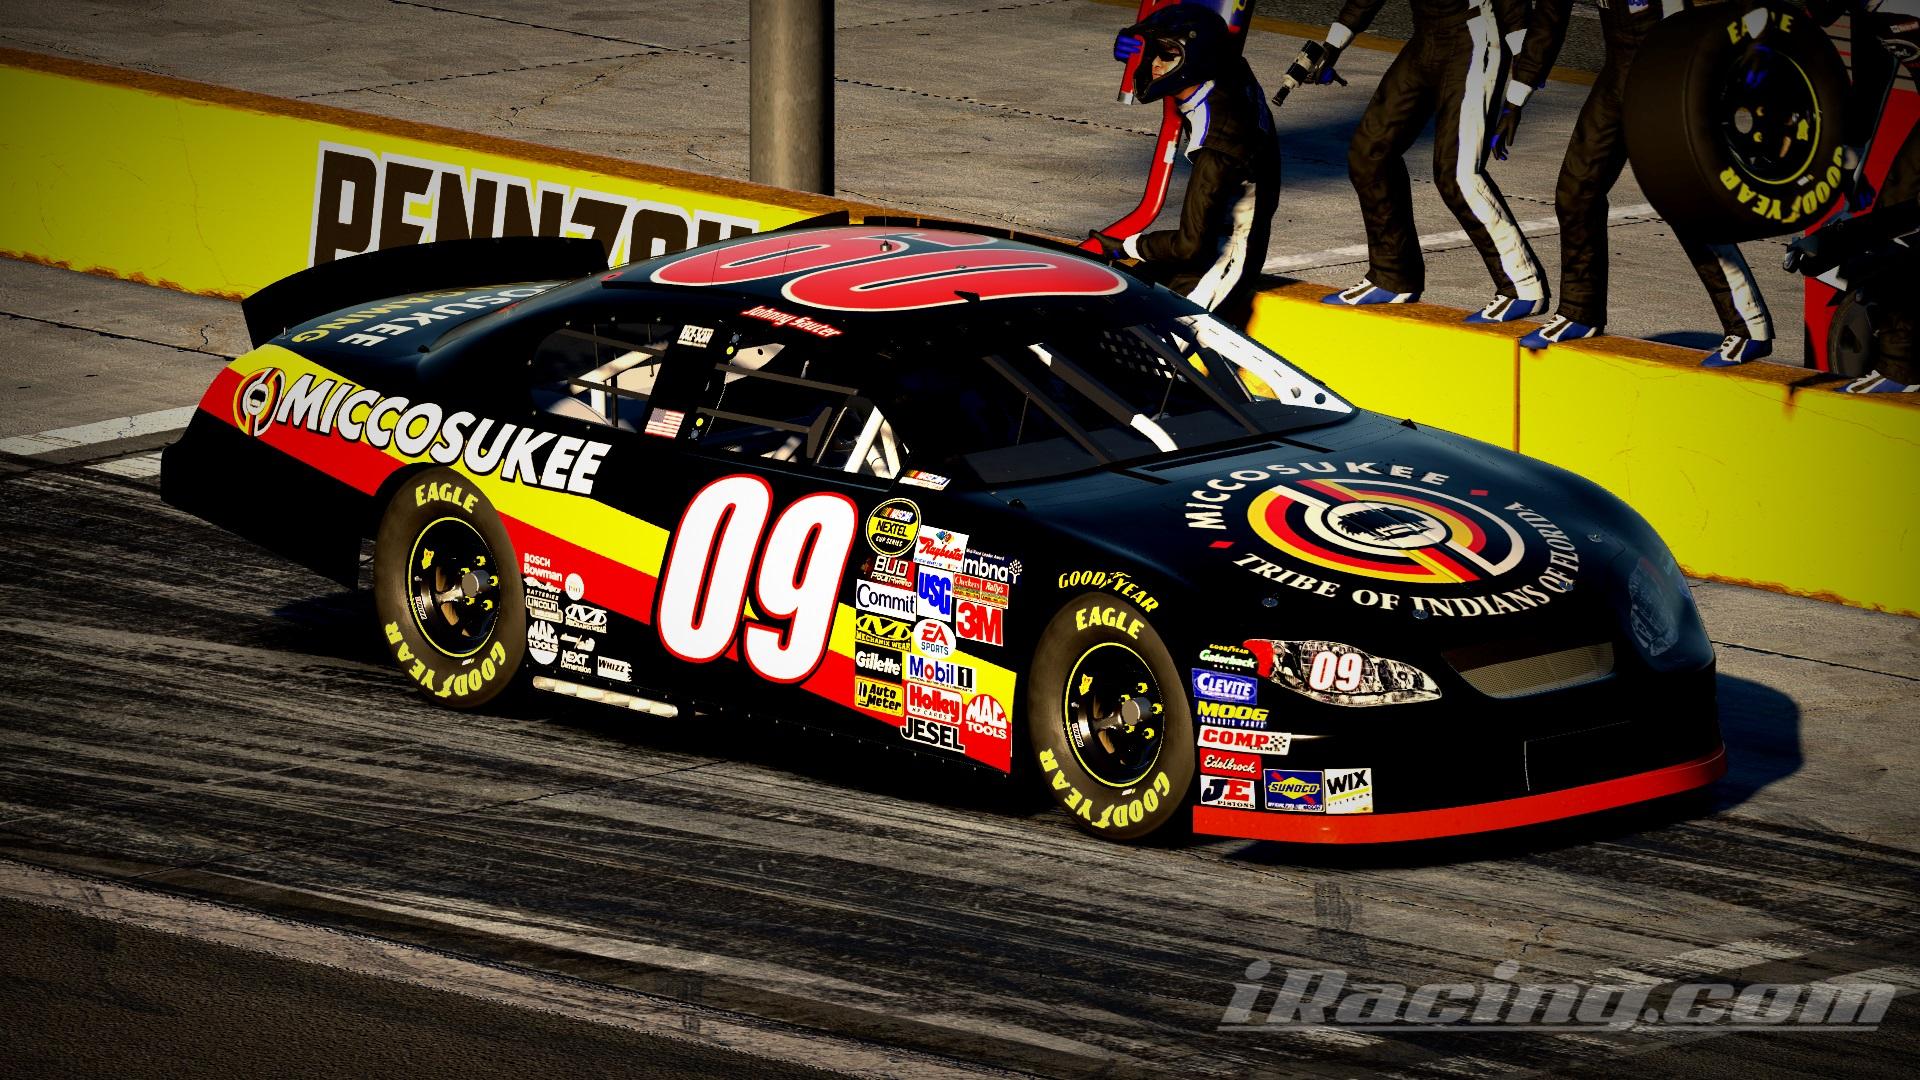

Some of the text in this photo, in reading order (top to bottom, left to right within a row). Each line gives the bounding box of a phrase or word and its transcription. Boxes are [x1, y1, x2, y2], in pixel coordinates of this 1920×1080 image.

[741, 305, 843, 338] Johnny Sauter
[276, 373, 612, 496] MICCOSUKEE
[415, 482, 479, 513] EAGLE
[1185, 461, 1450, 530] MICCOSUKEE
[875, 535, 887, 543] CUP
[876, 519, 908, 538] NEXTEL
[524, 553, 551, 567] BOSCH
[874, 555, 909, 577] BUD
[963, 557, 1009, 583] mbna
[1233, 501, 1580, 617] TRIBE OF INDIANS OF FLORIDA
[524, 563, 563, 582] Bowman
[659, 475, 860, 683] 09
[526, 588, 559, 600] BATTERIES
[857, 583, 914, 614] Commit
[918, 572, 951, 616] USG
[1058, 570, 1160, 613] GOODYEAR
[528, 598, 557, 612] LINCOLN
[528, 620, 559, 645] MAC
[921, 622, 948, 646] EA
[956, 602, 1003, 645] 3M
[1076, 606, 1145, 640] EAGLE
[528, 639, 559, 654] TOOLS
[856, 630, 911, 652] MECHANIX WEAR
[921, 641, 949, 656] SPORTS
[1209, 643, 1249, 654] GOODYEAR
[385, 621, 506, 698] GOODYEAR
[560, 661, 592, 674] Dimension
[561, 650, 589, 667] NEXT
[598, 659, 625, 673] WHIZZ
[856, 651, 900, 676] Gillette
[909, 655, 954, 685] Mobil
[1309, 651, 1362, 691] 09
[869, 683, 896, 699] Auto
[1197, 672, 1252, 697] CLEVITE
[867, 694, 902, 711] Meter
[909, 684, 960, 723] Holley
[965, 695, 1007, 729] MAC
[1197, 701, 1269, 721] MOOG
[901, 717, 965, 751] JESEL
[965, 721, 1007, 739] TOOLS
[1201, 716, 1264, 729] CHASSIS PARTS
[1202, 728, 1270, 748] COMP
[1203, 754, 1256, 774] Edelbrock
[1039, 748, 1171, 829] GOODYEAR
[1201, 778, 1251, 803] JE
[1270, 783, 1318, 793] SUNOCO
[1326, 769, 1369, 794] WIX
[1217, 800, 1254, 808] PISTONS
